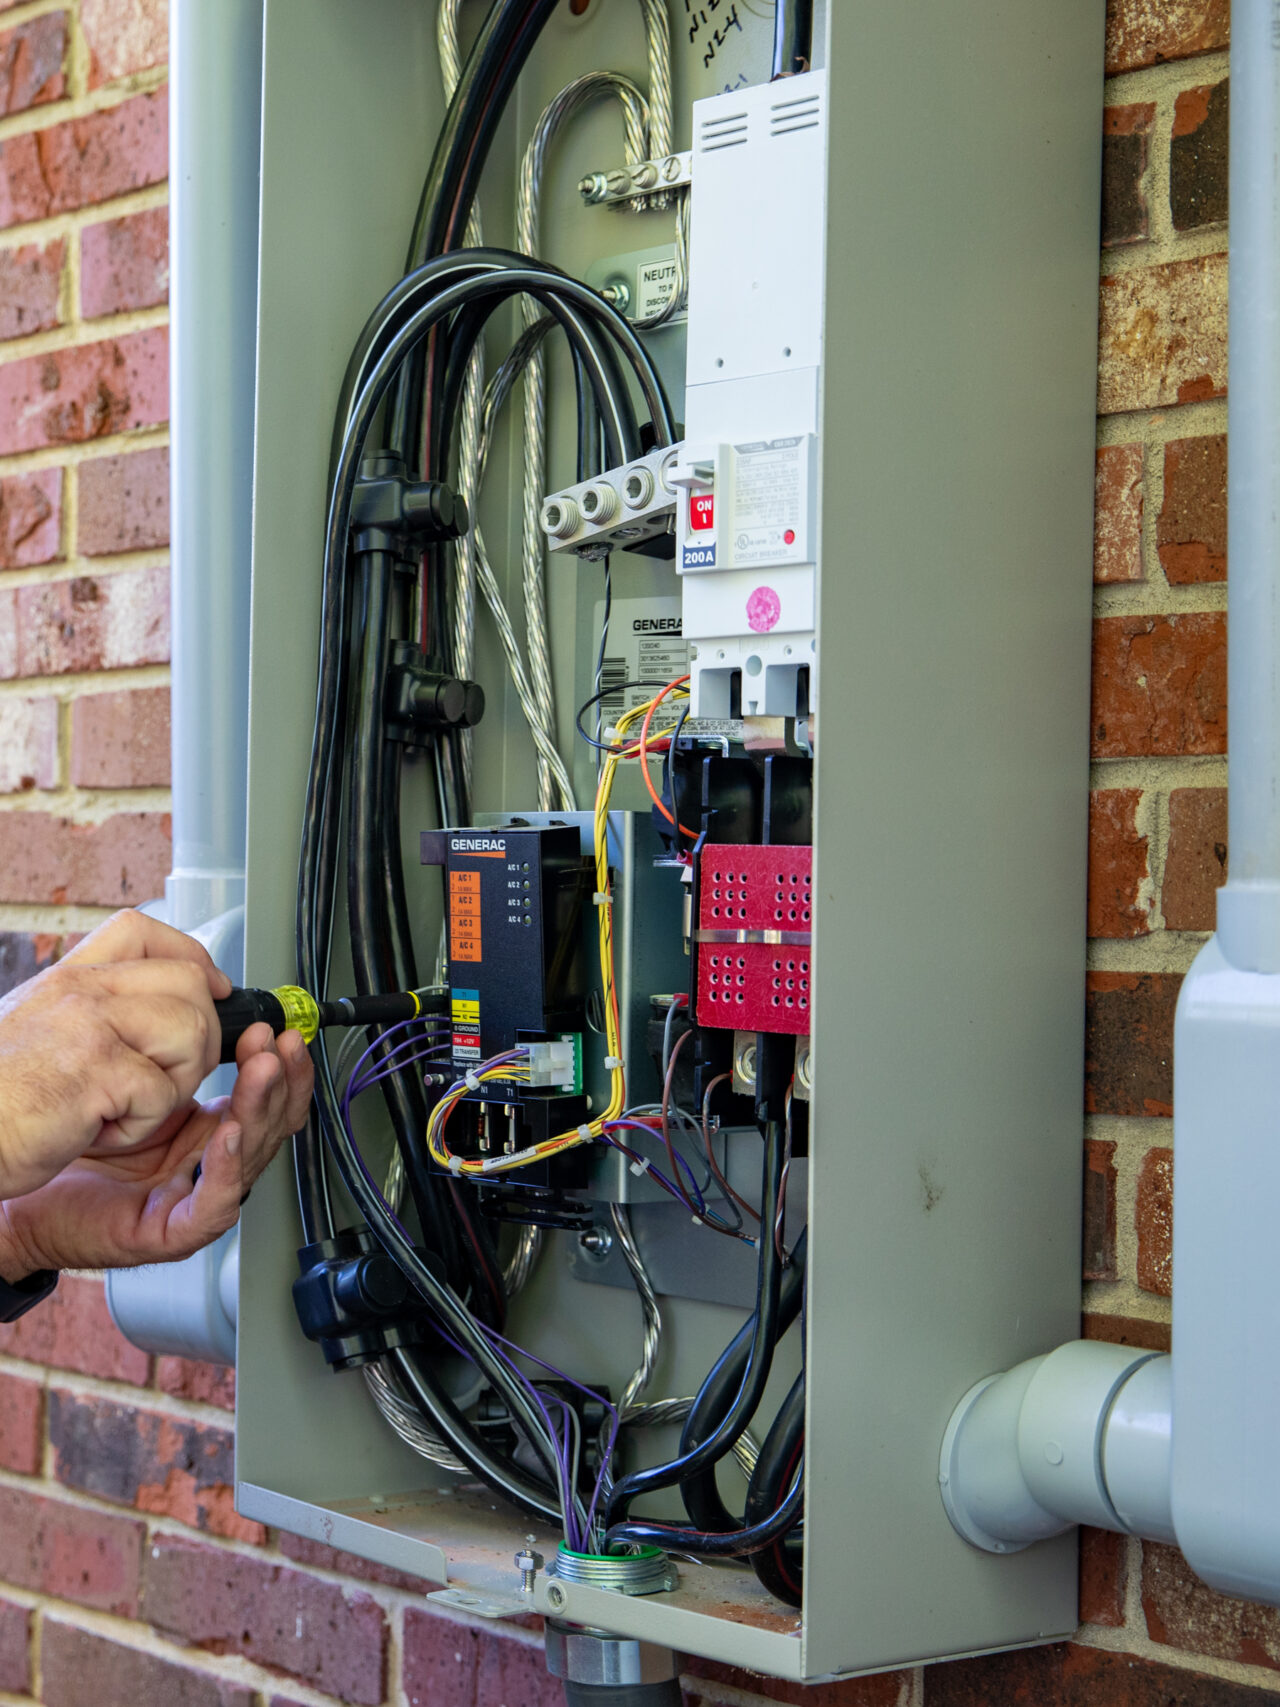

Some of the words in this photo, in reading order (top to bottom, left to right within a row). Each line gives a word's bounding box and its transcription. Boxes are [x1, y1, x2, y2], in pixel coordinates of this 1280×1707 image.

[696, 500, 713, 512] ON
[684, 550, 714, 564] 200A
[451, 839, 506, 851] GENERAC
[480, 1085, 488, 1094] N1
[506, 1087, 514, 1097] T1
